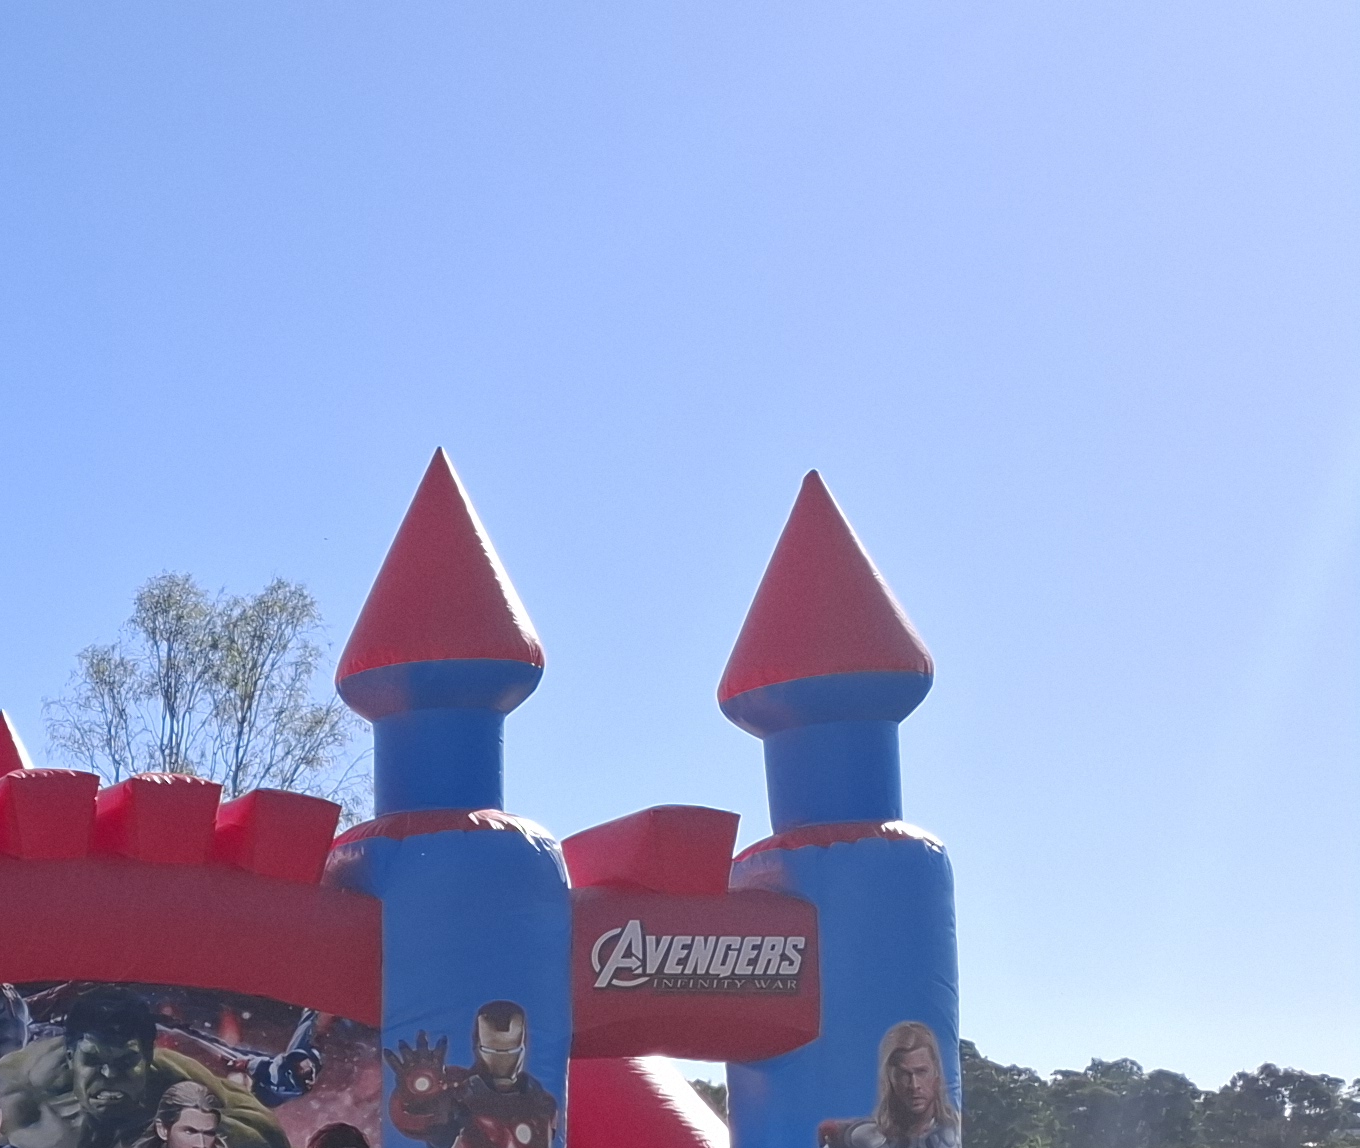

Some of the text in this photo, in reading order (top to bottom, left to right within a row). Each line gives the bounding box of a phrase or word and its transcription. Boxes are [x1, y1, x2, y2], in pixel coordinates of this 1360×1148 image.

[592, 920, 805, 988] AVENGERS
[653, 978, 797, 989] INFINITY WAR
